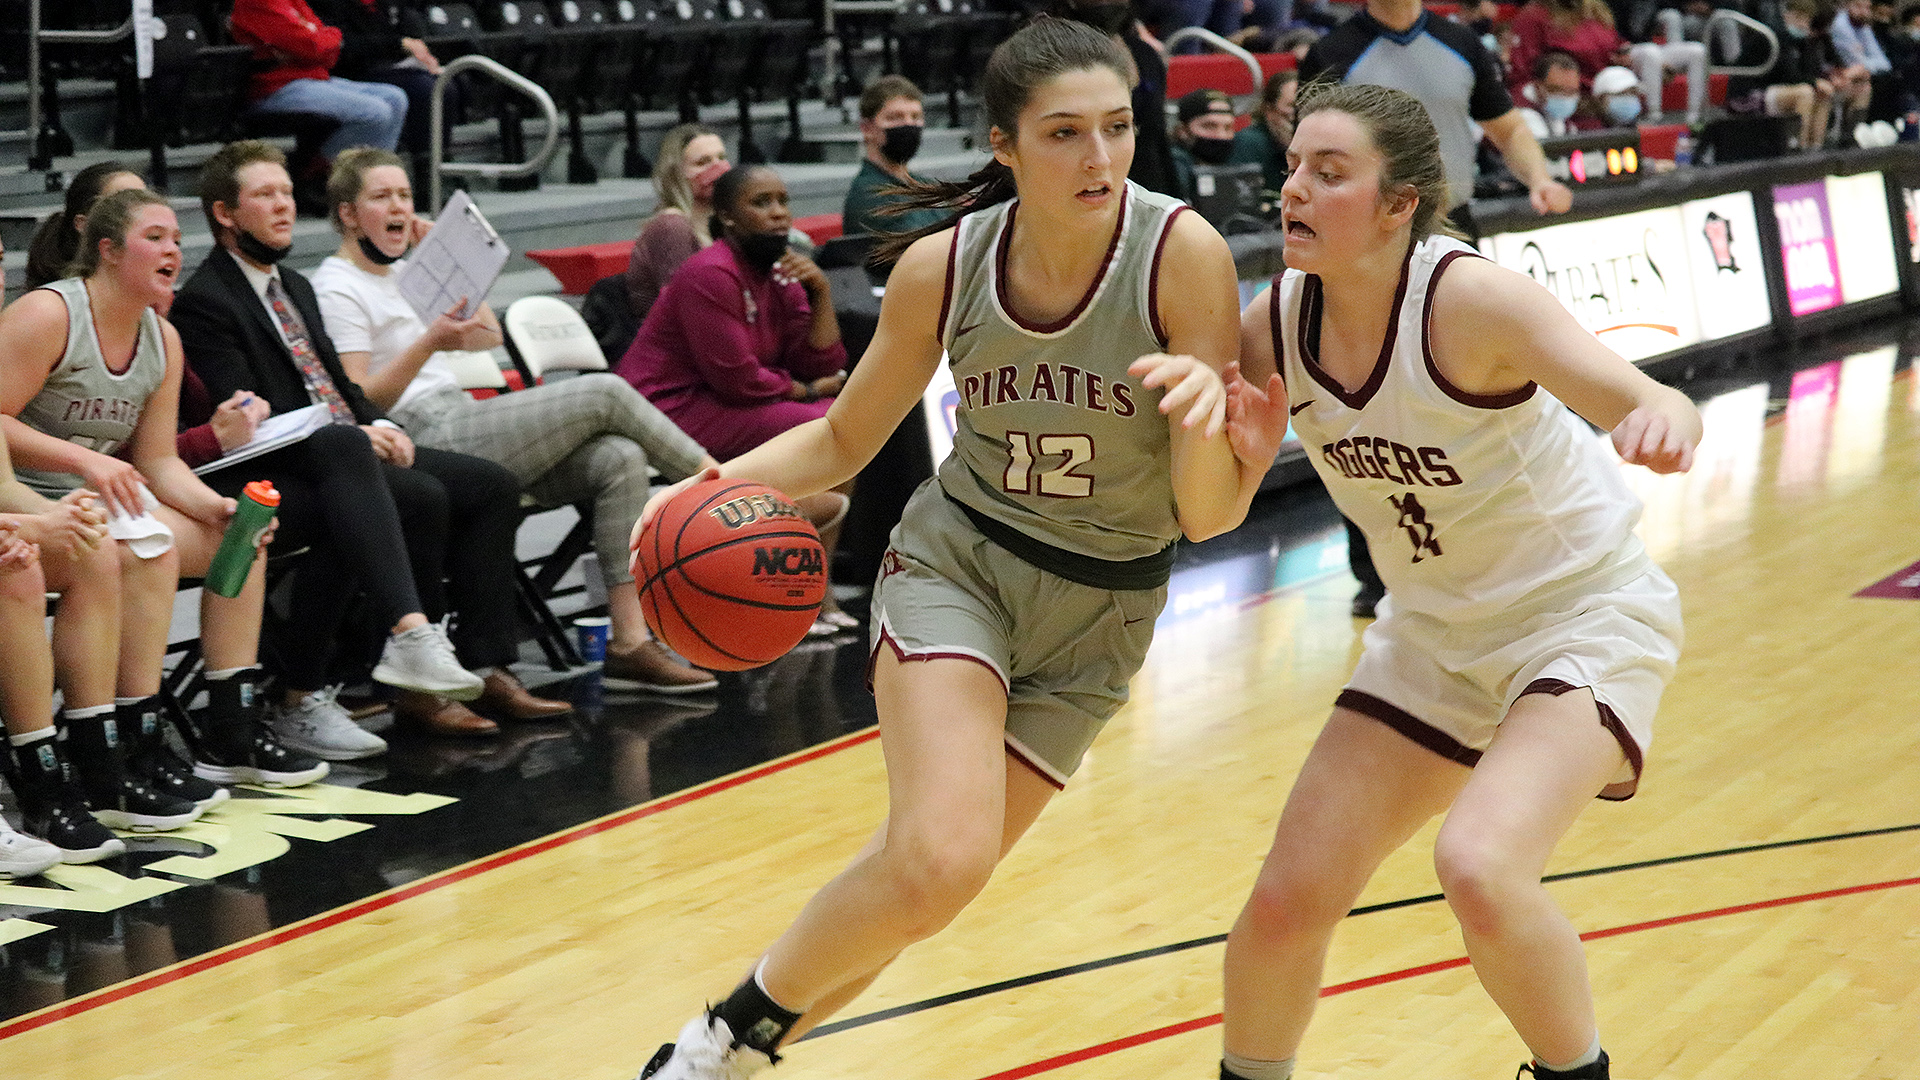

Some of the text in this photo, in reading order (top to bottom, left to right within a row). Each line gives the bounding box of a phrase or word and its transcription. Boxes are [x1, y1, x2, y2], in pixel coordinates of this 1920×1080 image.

[962, 362, 1137, 418] PIRATES
[60, 397, 139, 428] PIRATE
[1003, 430, 1095, 498] 12
[752, 548, 823, 576] NCAA
